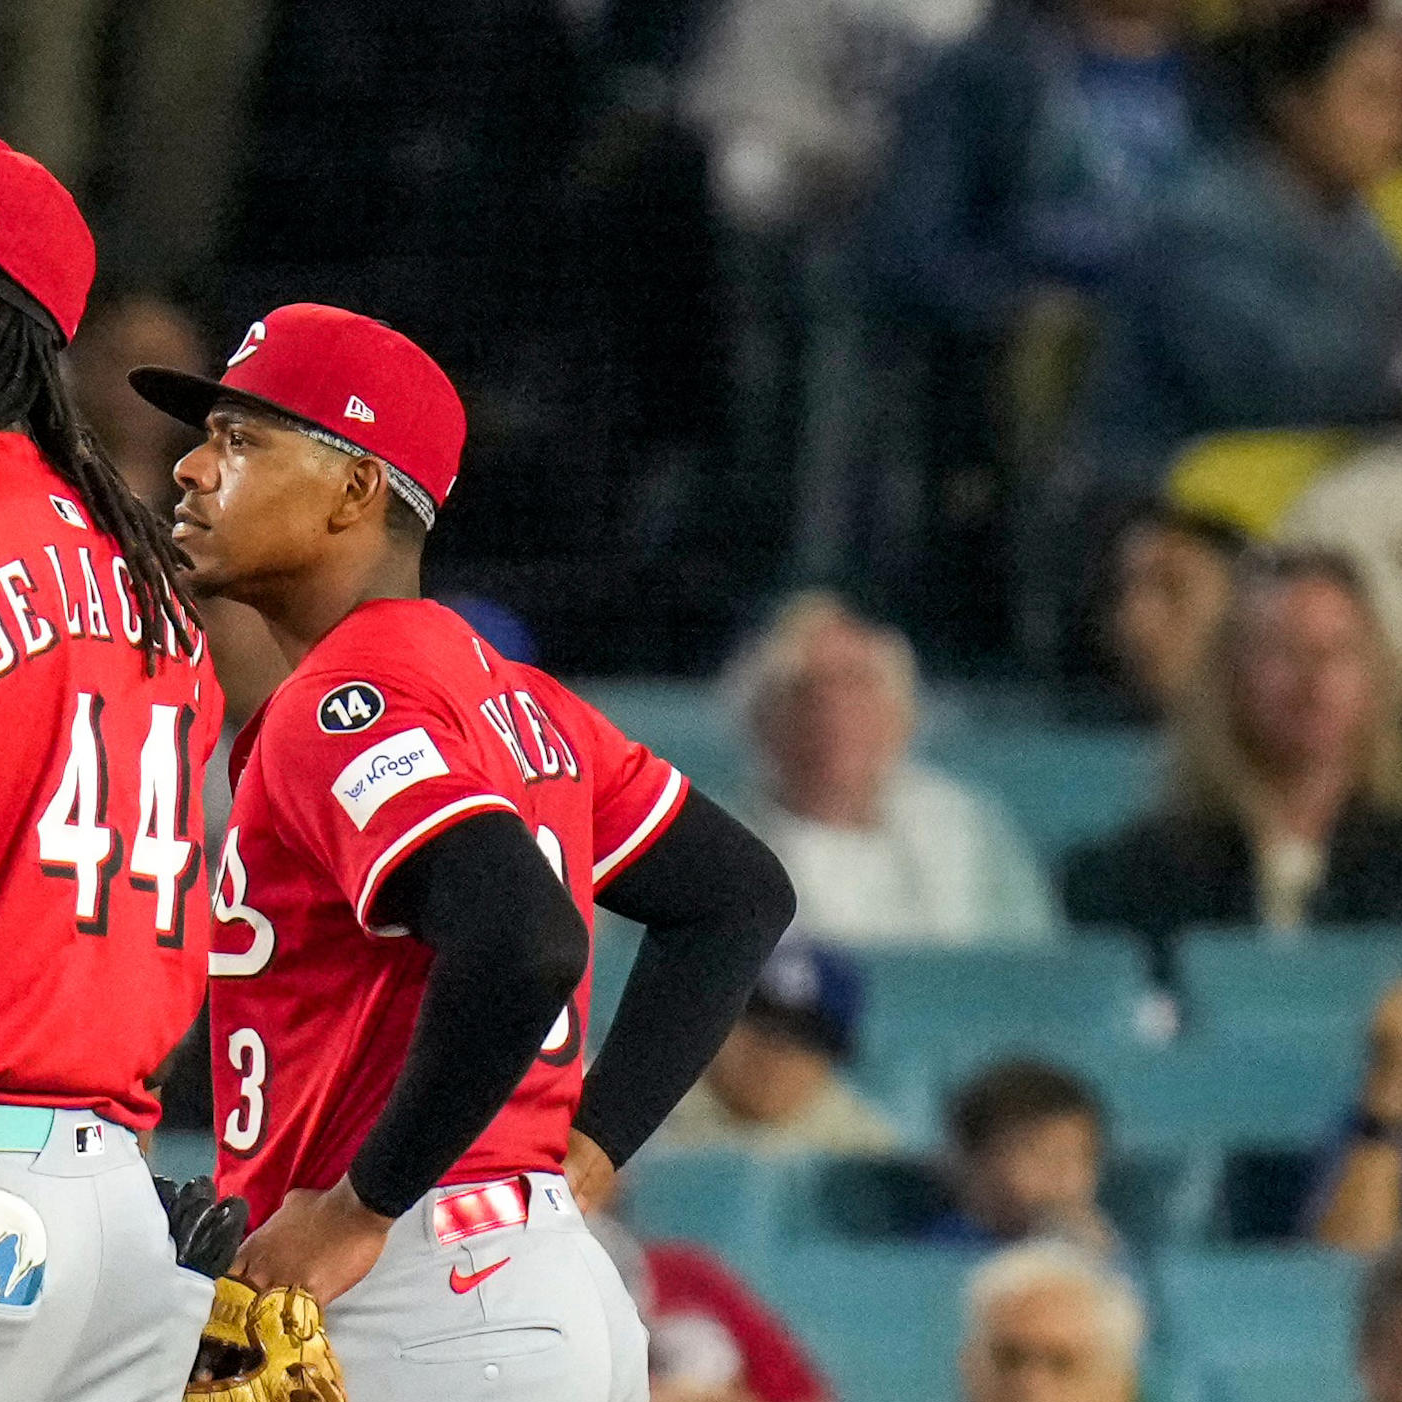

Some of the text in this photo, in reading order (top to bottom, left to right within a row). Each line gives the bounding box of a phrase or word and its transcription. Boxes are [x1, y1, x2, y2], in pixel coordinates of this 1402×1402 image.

[43, 545, 113, 642] LA
[327, 689, 371, 727] 14
[365, 748, 426, 784] Kroger
[37, 691, 199, 946] 44
[223, 1027, 268, 1153] 3
